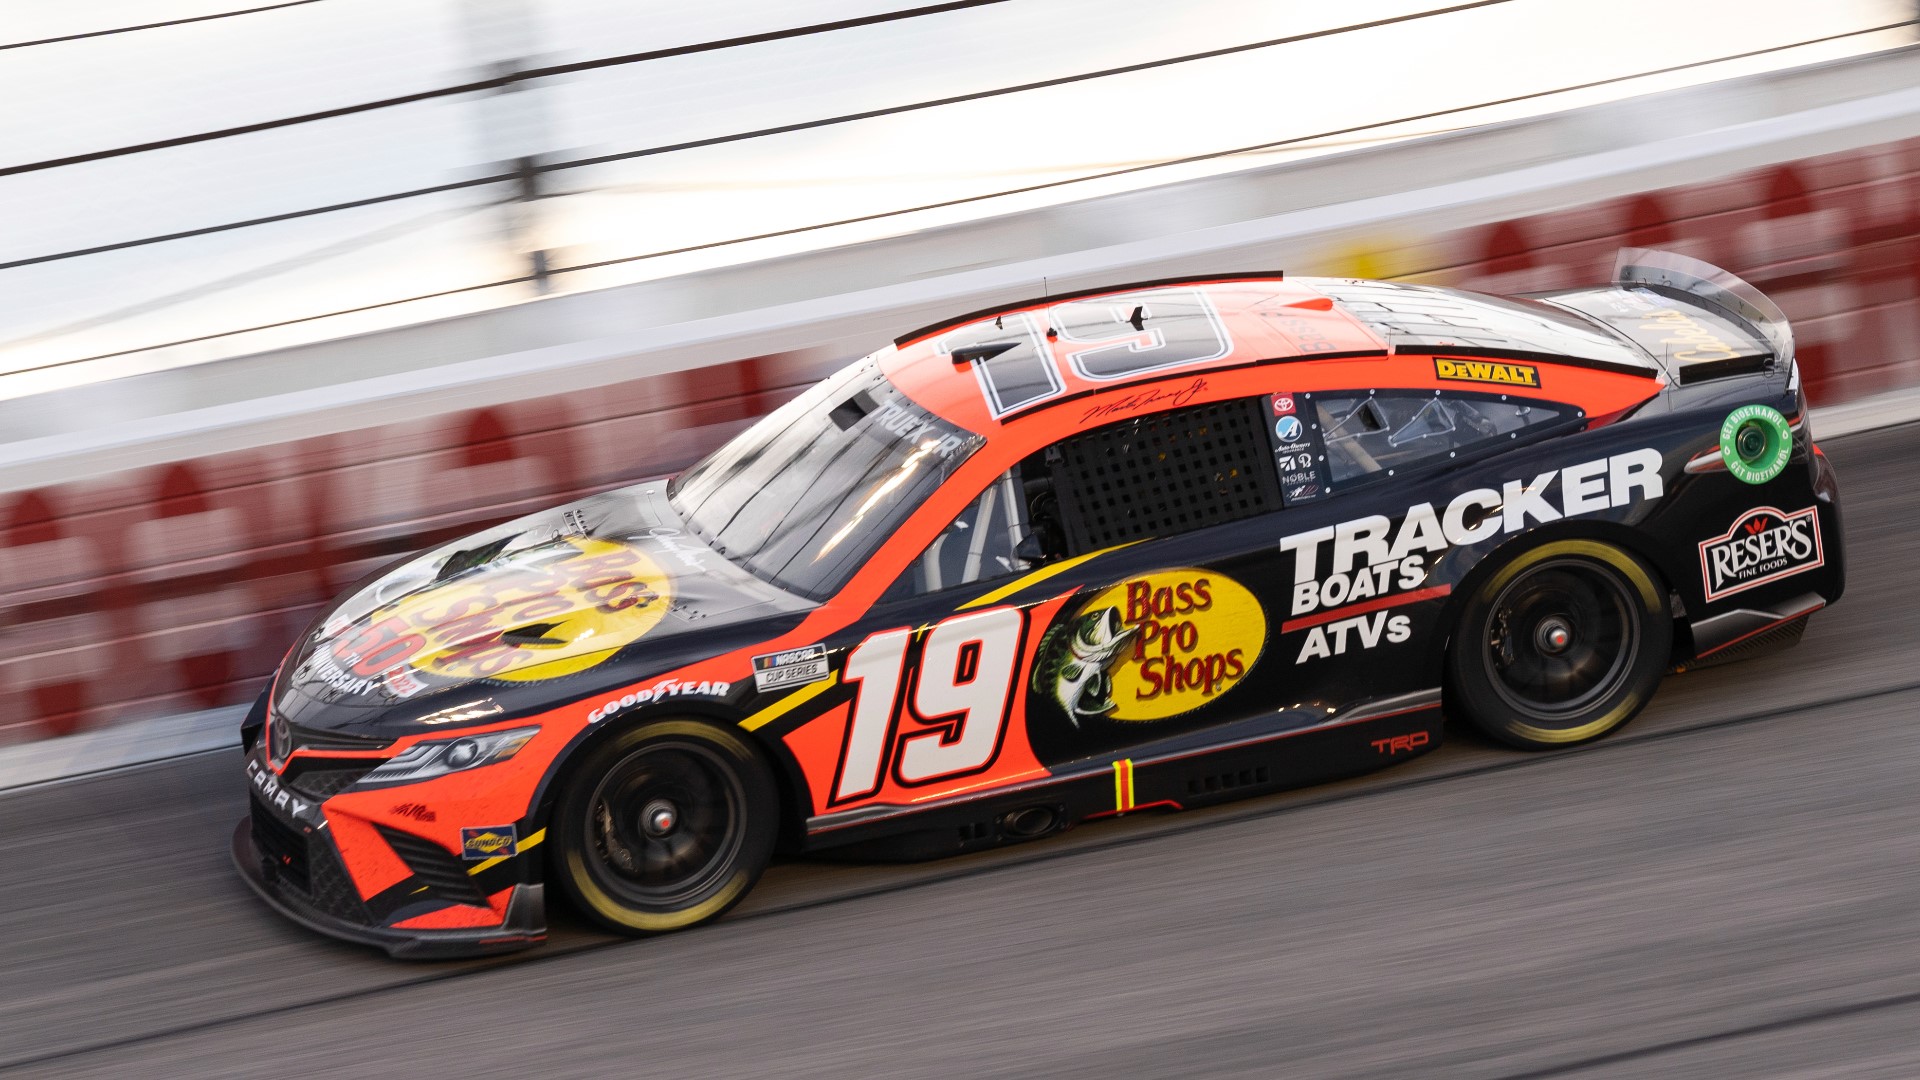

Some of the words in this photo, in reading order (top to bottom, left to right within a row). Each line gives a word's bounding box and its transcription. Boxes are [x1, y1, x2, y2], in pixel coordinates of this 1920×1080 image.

[932, 286, 1234, 420] 19
[869, 400, 936, 444] TRUEX
[1722, 422, 1734, 440] GET
[1730, 406, 1783, 428] BIOETHANOL
[1282, 470, 1316, 485] NOBLE
[1730, 460, 1746, 477] GET
[1746, 447, 1790, 482] BIOETHANOL
[1280, 447, 1664, 585] TRACKER
[1711, 519, 1812, 590] RESER'S
[1739, 568, 1758, 580] FINE
[1760, 557, 1788, 573] FOODS
[1124, 578, 1212, 624] Bass
[1291, 555, 1424, 616] BOATS
[331, 616, 427, 676] 50
[775, 648, 815, 667] NASCAR
[1131, 620, 1198, 661] Pro
[1296, 611, 1412, 665] ATVs
[765, 670, 784, 683] CUP
[785, 664, 818, 680] SERIES
[1136, 648, 1244, 699] Shops
[587, 678, 731, 724] GOODYEAR
[836, 605, 1026, 803] 19
[1371, 731, 1429, 755] TRD
[246, 759, 309, 818] CAMRY
[464, 835, 513, 849] SUNOCO
